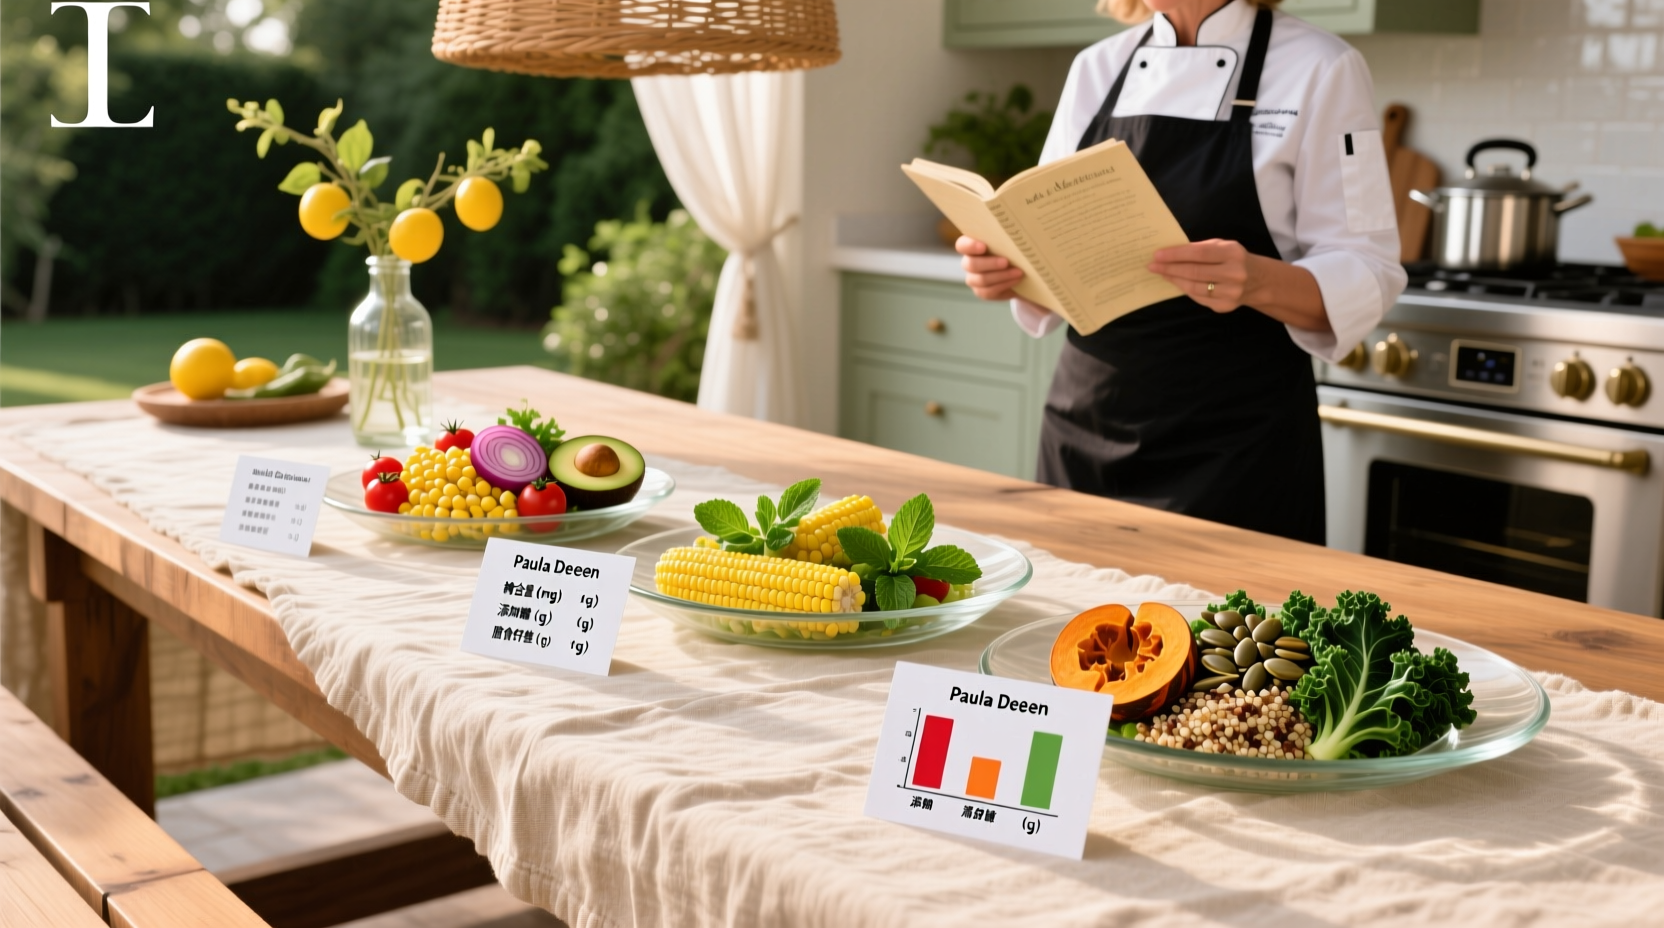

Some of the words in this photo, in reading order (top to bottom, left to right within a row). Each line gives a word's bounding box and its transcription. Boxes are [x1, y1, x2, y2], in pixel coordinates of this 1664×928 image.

[513, 554, 551, 573] Paula
[553, 559, 600, 580] Deeen
[949, 686, 994, 708] Paula
[997, 693, 1049, 717] Deeen
[1022, 816, 1042, 836] (g)
